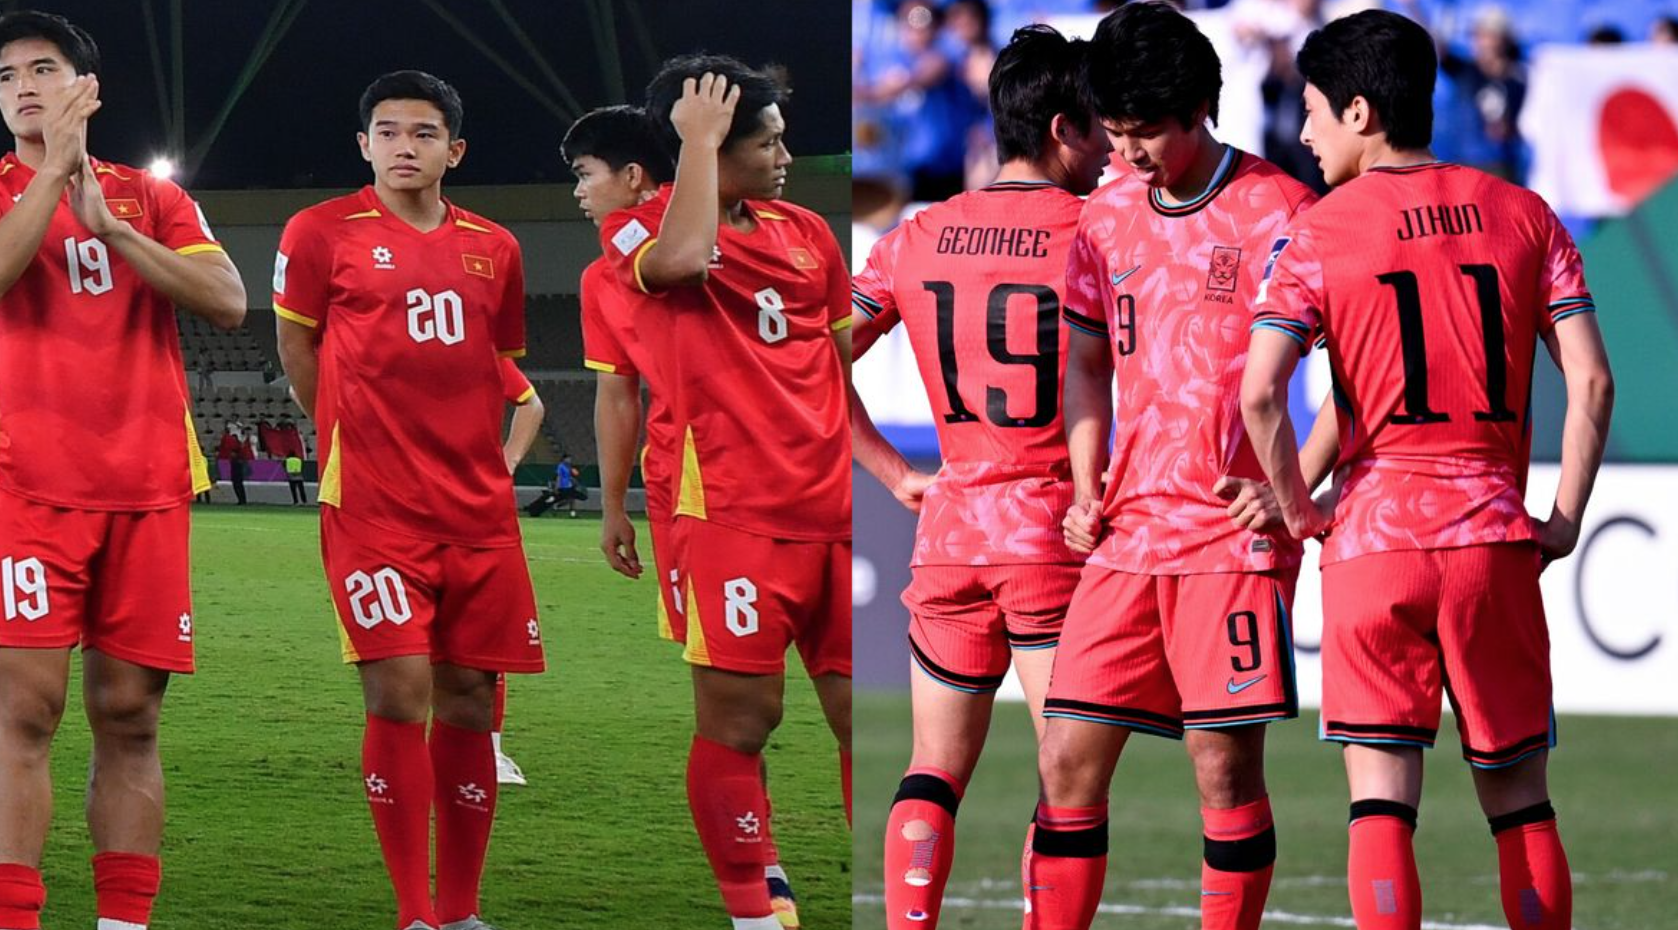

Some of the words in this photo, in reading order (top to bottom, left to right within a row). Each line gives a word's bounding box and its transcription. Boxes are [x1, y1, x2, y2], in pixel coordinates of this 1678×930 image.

[937, 226, 1051, 258] GEONHEE
[1396, 202, 1483, 240] JIHUN
[64, 236, 113, 295] 19
[406, 288, 465, 345] 20
[754, 287, 788, 343] 8
[1115, 293, 1136, 356] 9
[1204, 293, 1233, 305] KOREA
[922, 280, 1060, 428] 19
[1376, 263, 1518, 424] 11
[2, 556, 49, 621] 19
[345, 566, 413, 629] 20
[724, 577, 759, 637] 8
[1227, 610, 1262, 672] 9
